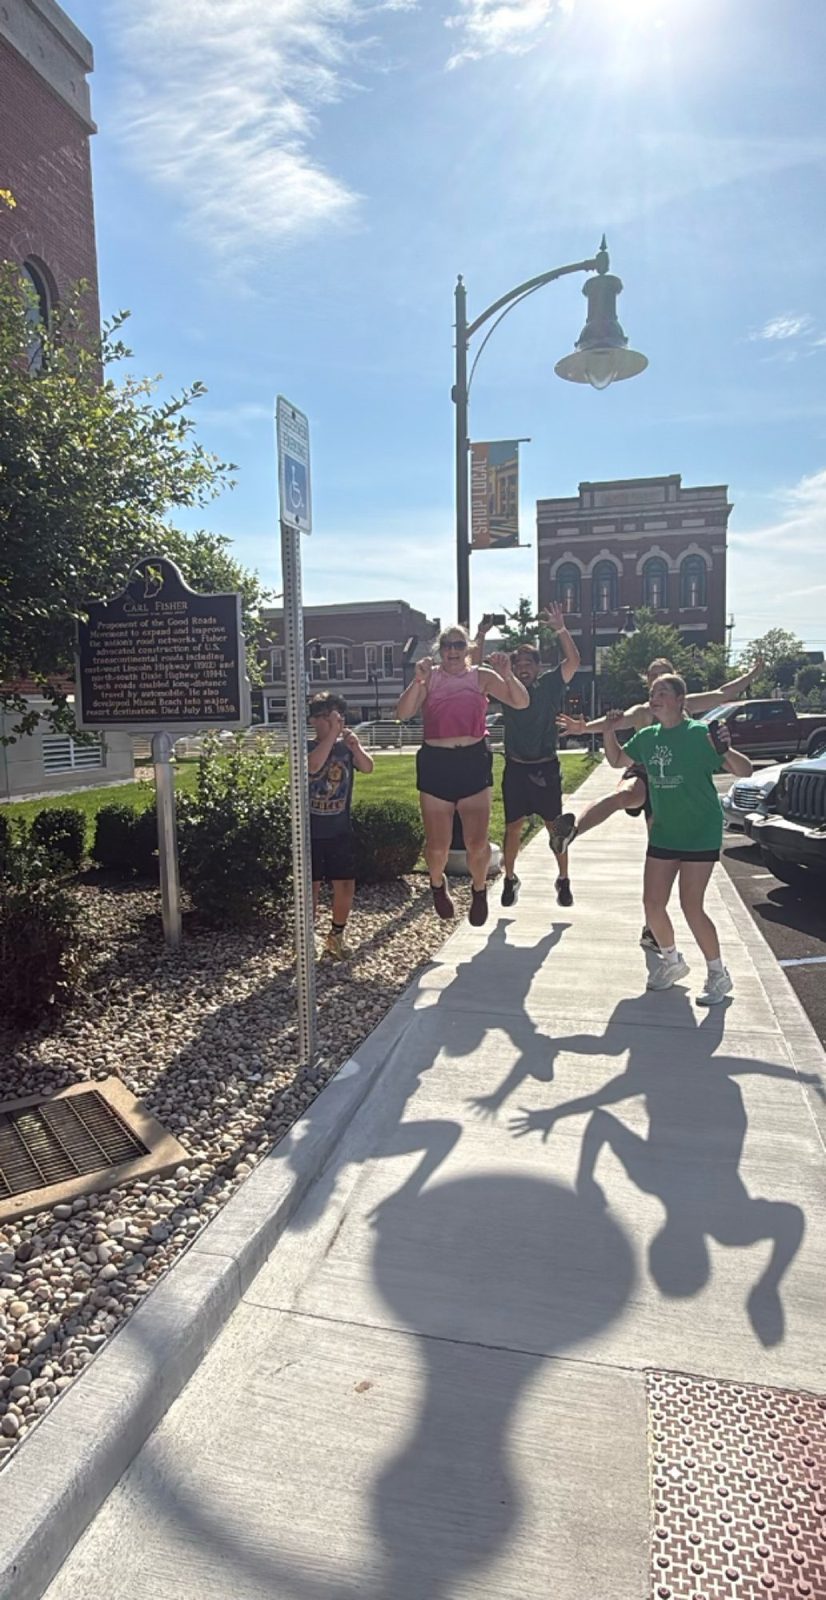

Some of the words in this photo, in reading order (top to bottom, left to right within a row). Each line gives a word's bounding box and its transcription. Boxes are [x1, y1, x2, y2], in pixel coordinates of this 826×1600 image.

[472, 458, 487, 496] LOCAL
[473, 500, 488, 534] SHOP
[123, 603, 149, 612] CARL
[155, 601, 188, 611] FISHER
[97, 621, 138, 630] Proponent
[152, 619, 164, 627] the
[167, 618, 189, 626] Good
[192, 616, 217, 625] Roads
[90, 630, 128, 638] Movement
[142, 628, 171, 640] expand
[173, 627, 189, 635] and
[192, 626, 226, 636] improve
[136, 637, 155, 645] road
[201, 634, 228, 643] Fisher
[96, 646, 136, 656] advocated
[138, 645, 190, 654] construction
[192, 643, 202, 651] of
[92, 654, 158, 664] transcontinental
[161, 653, 184, 662] roads
[186, 653, 225, 662] including
[123, 664, 152, 672] Lincoln
[154, 662, 191, 672] Highway
[219, 660, 235, 669] and
[91, 673, 138, 682] north-south
[141, 672, 161, 680] Dixie
[164, 670, 200, 680] Highway
[92, 682, 111, 690] Such
[114, 681, 137, 689] roads
[139, 680, 170, 689] enabled
[172, 680, 227, 689] long-distance
[101, 689, 124, 698] travel
[127, 689, 138, 699] by
[189, 688, 200, 696] He
[203, 687, 220, 696] also
[93, 699, 130, 708] developed
[133, 697, 157, 706] Miami
[159, 697, 182, 706] Beach
[184, 697, 201, 705] into
[203, 696, 229, 706] major
[86, 708, 110, 716] resort
[161, 705, 180, 714] Died
[182, 705, 200, 715] July
